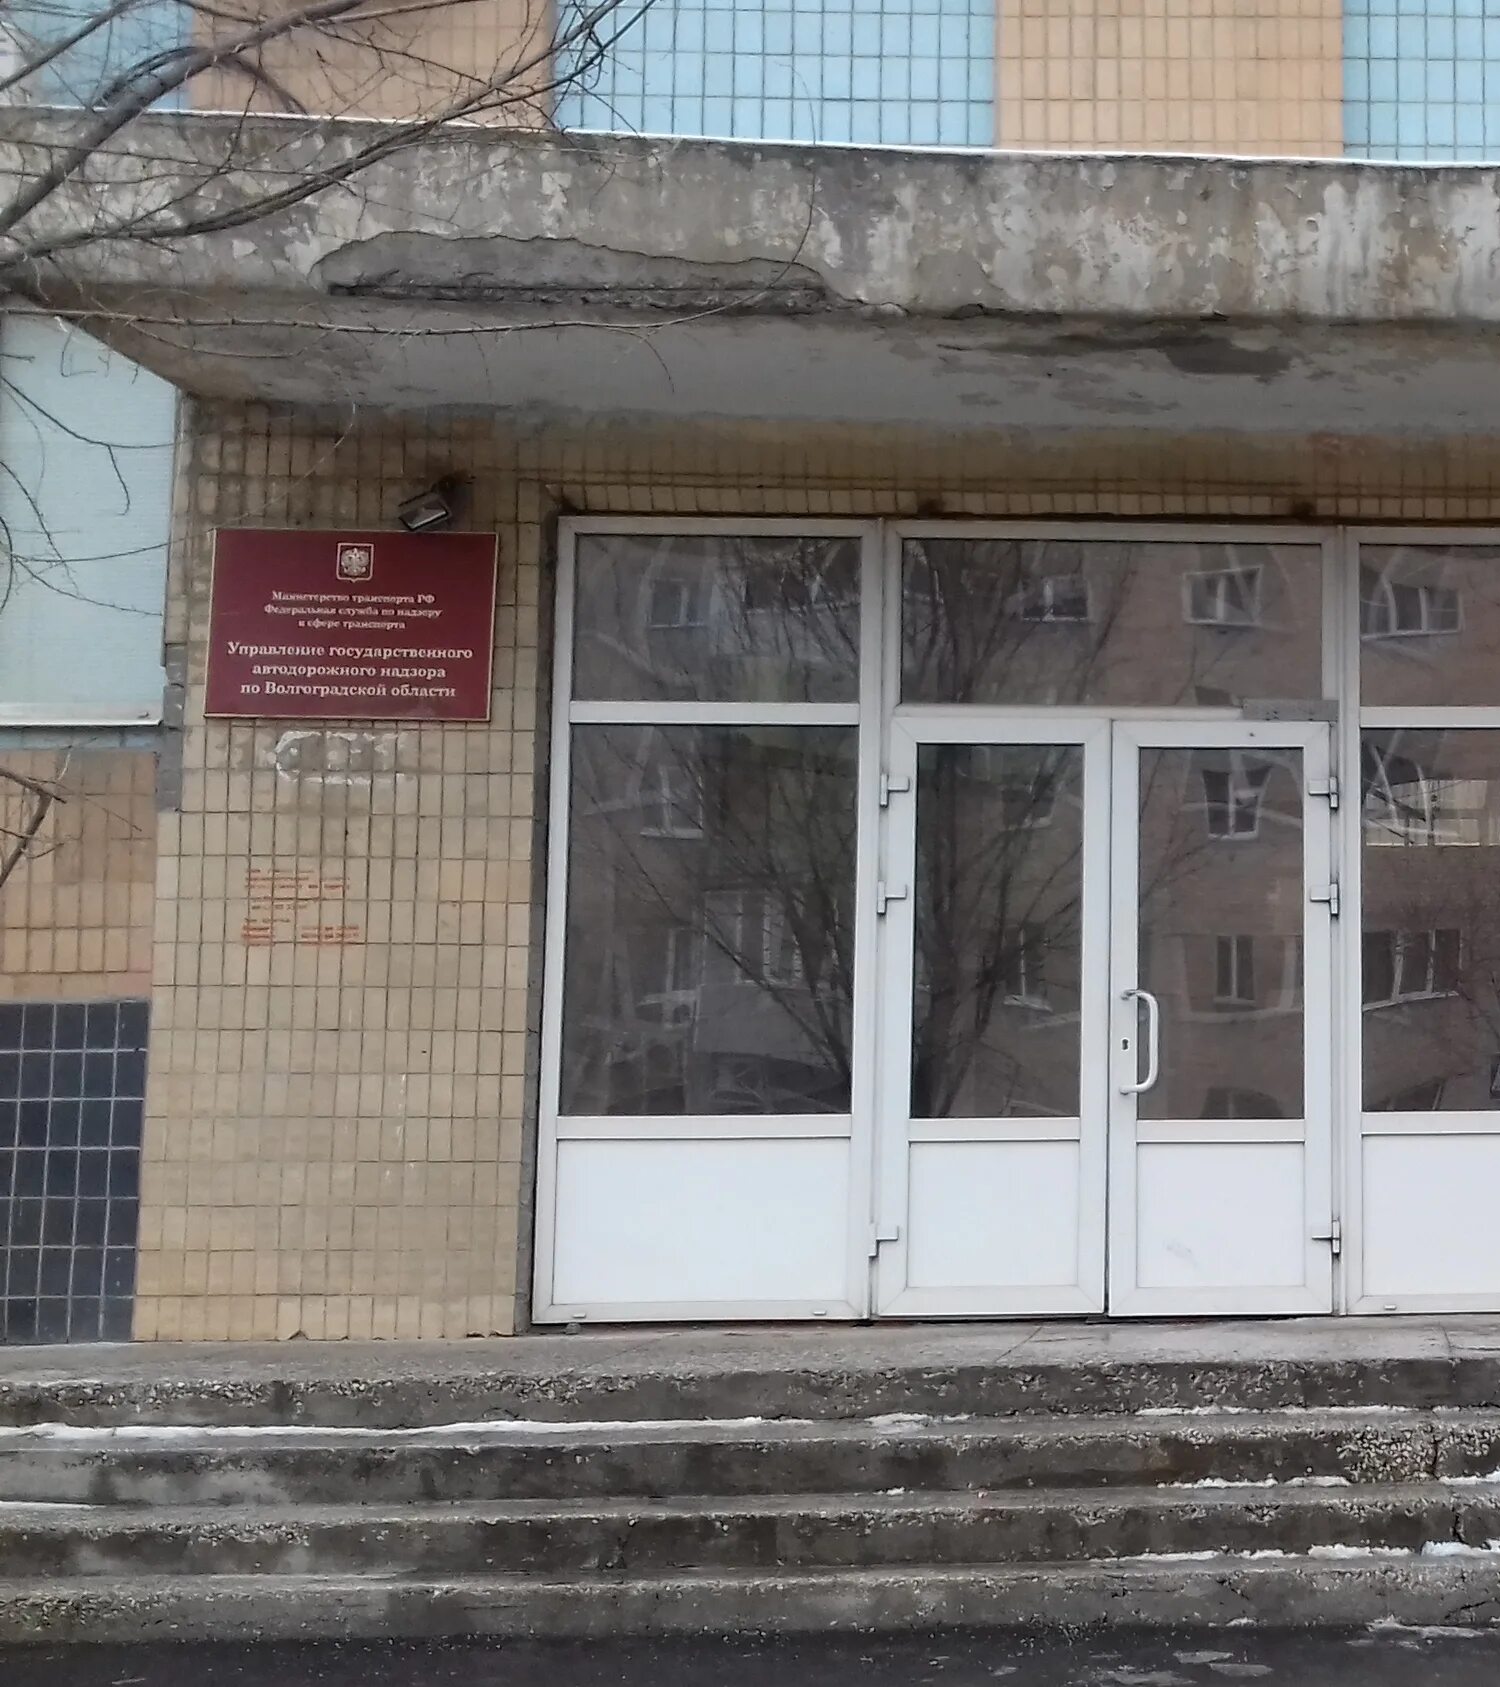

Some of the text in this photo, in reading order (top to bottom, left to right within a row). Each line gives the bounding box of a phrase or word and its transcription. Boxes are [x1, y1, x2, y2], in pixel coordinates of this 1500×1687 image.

[272, 591, 435, 604] Министерство транспорта РФ
[264, 604, 336, 615] Федеральная
[338, 606, 379, 617] служба
[397, 609, 442, 618] надзору
[307, 618, 340, 630] сфере
[343, 622, 406, 631] транспорта
[227, 641, 474, 659] Управление государственного
[252, 664, 446, 679] автодорожного надзора
[240, 681, 456, 697] по Волгоградской области
